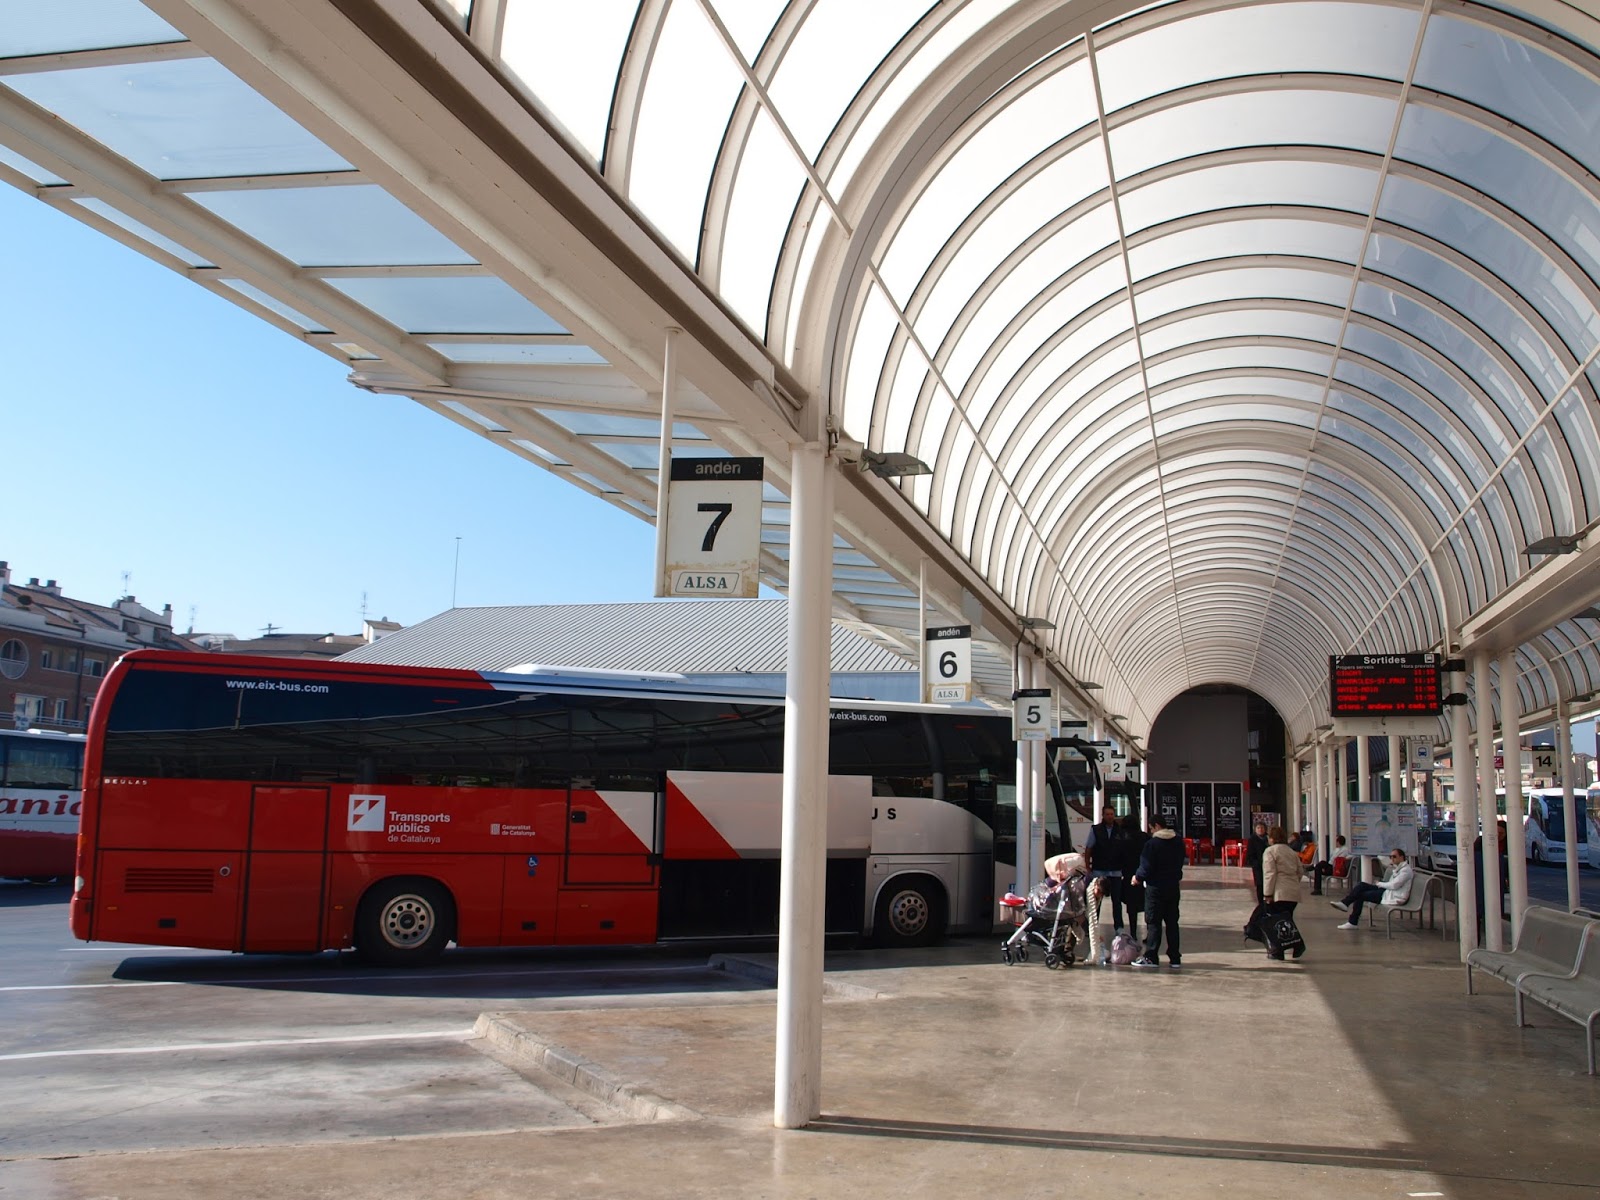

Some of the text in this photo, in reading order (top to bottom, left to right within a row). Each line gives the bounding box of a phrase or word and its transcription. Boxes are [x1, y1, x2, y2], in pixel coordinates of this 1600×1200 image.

[694, 462, 741, 476] andén
[697, 503, 733, 552] 7
[683, 576, 728, 590] ALSA
[937, 627, 961, 637] andén
[938, 651, 958, 679] 6
[1363, 656, 1406, 665] Sortides
[225, 680, 329, 694] www.eix-bus.com
[937, 690, 959, 699] ALSA
[829, 711, 888, 722] w.eix-bus.com
[1026, 705, 1041, 724] 5
[1113, 762, 1120, 772] 2
[1535, 755, 1552, 768] 14
[1128, 770, 1133, 779] 1
[389, 811, 451, 824] Transports
[388, 822, 431, 834] públics
[387, 834, 441, 845] de Catalunya
